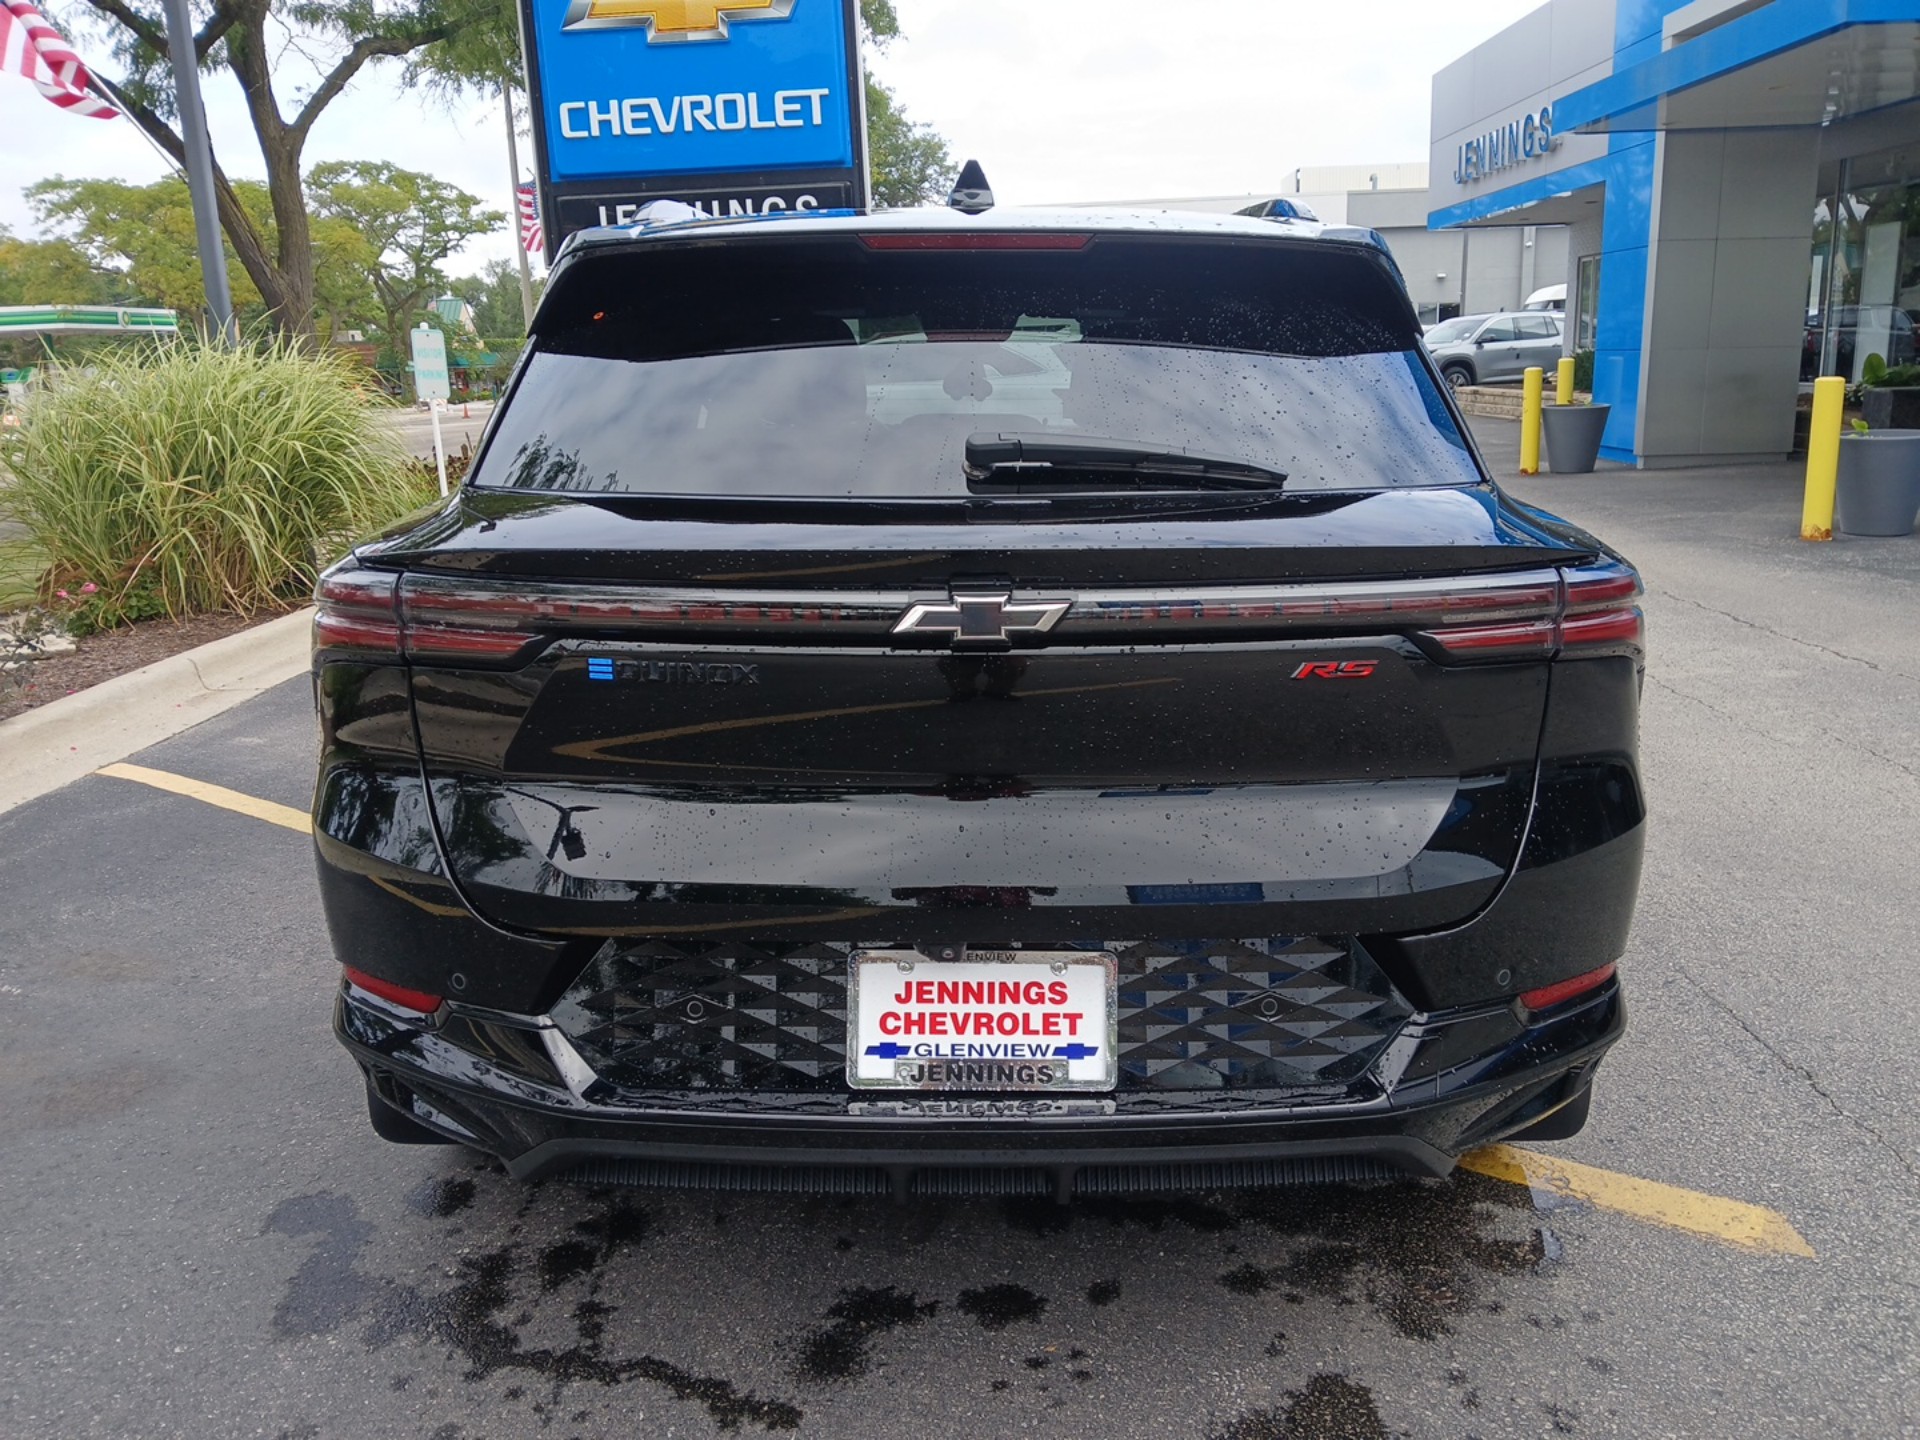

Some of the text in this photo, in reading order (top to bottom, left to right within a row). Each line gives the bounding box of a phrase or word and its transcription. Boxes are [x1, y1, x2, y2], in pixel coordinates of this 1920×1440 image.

[560, 88, 829, 138] CHEVROLET
[1453, 106, 1551, 184] JENNINGS
[598, 195, 819, 226] JEINGS
[1290, 660, 1379, 679] RS
[964, 951, 1017, 961] ENVIEW
[894, 981, 1068, 1005] JENNINGS
[879, 1012, 1083, 1036] CHEVROLET
[914, 1043, 1051, 1058] GLENVIEW
[910, 1064, 1053, 1084] JENNINGS
